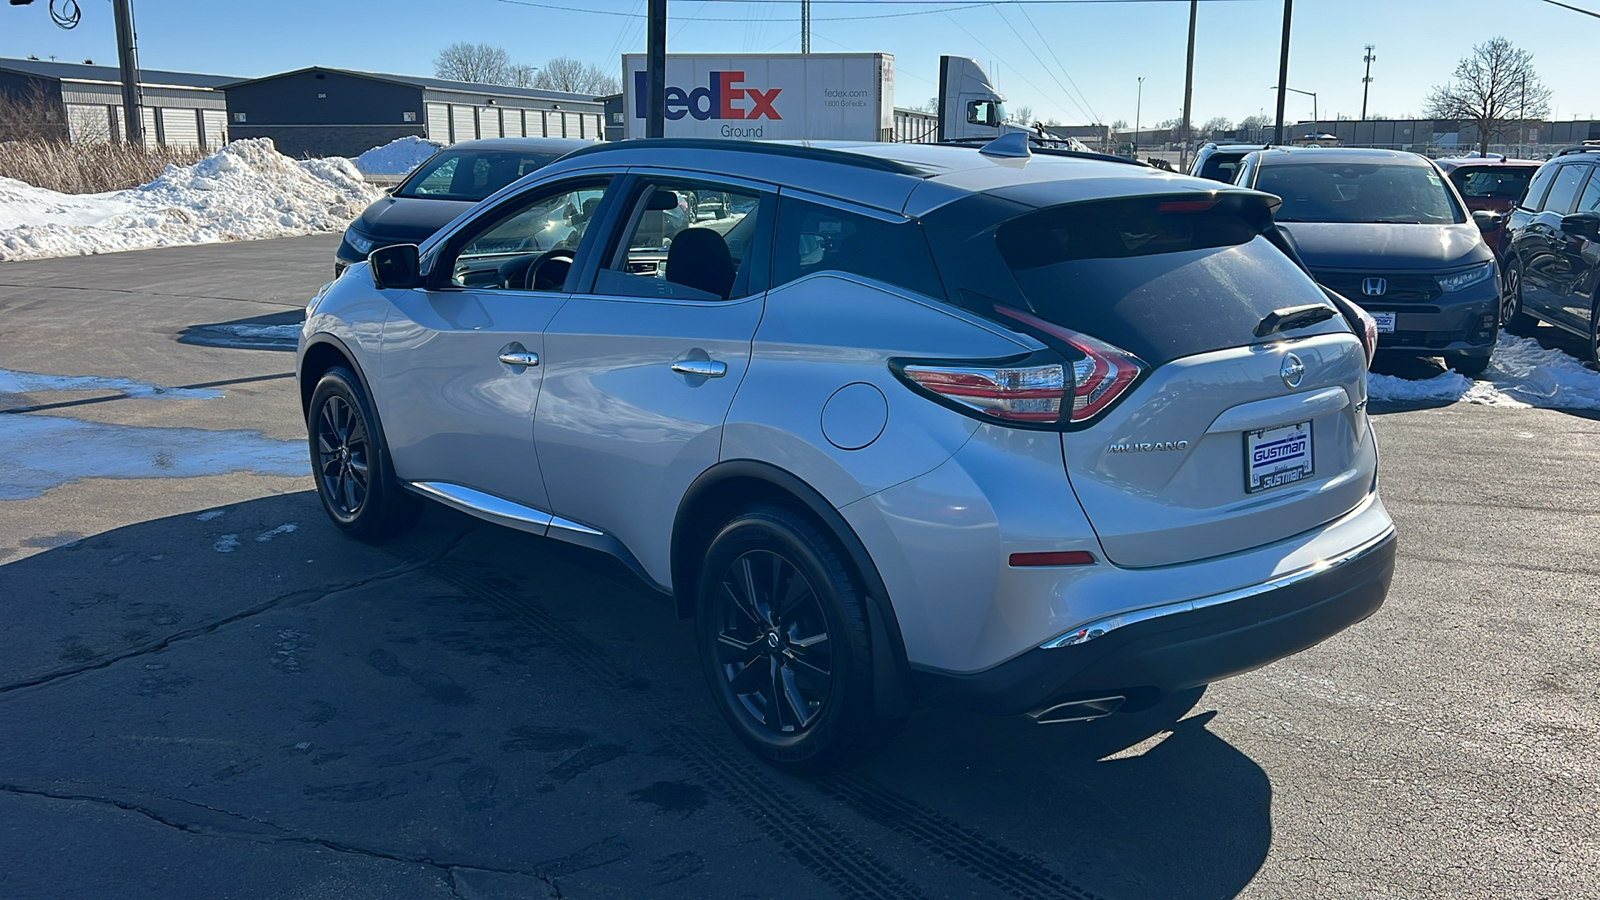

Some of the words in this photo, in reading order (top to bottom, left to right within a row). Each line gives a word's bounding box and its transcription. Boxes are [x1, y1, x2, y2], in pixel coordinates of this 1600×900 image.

[824, 88, 868, 98] fedex.com
[721, 125, 763, 138] Ground
[1107, 440, 1188, 453] MURANO
